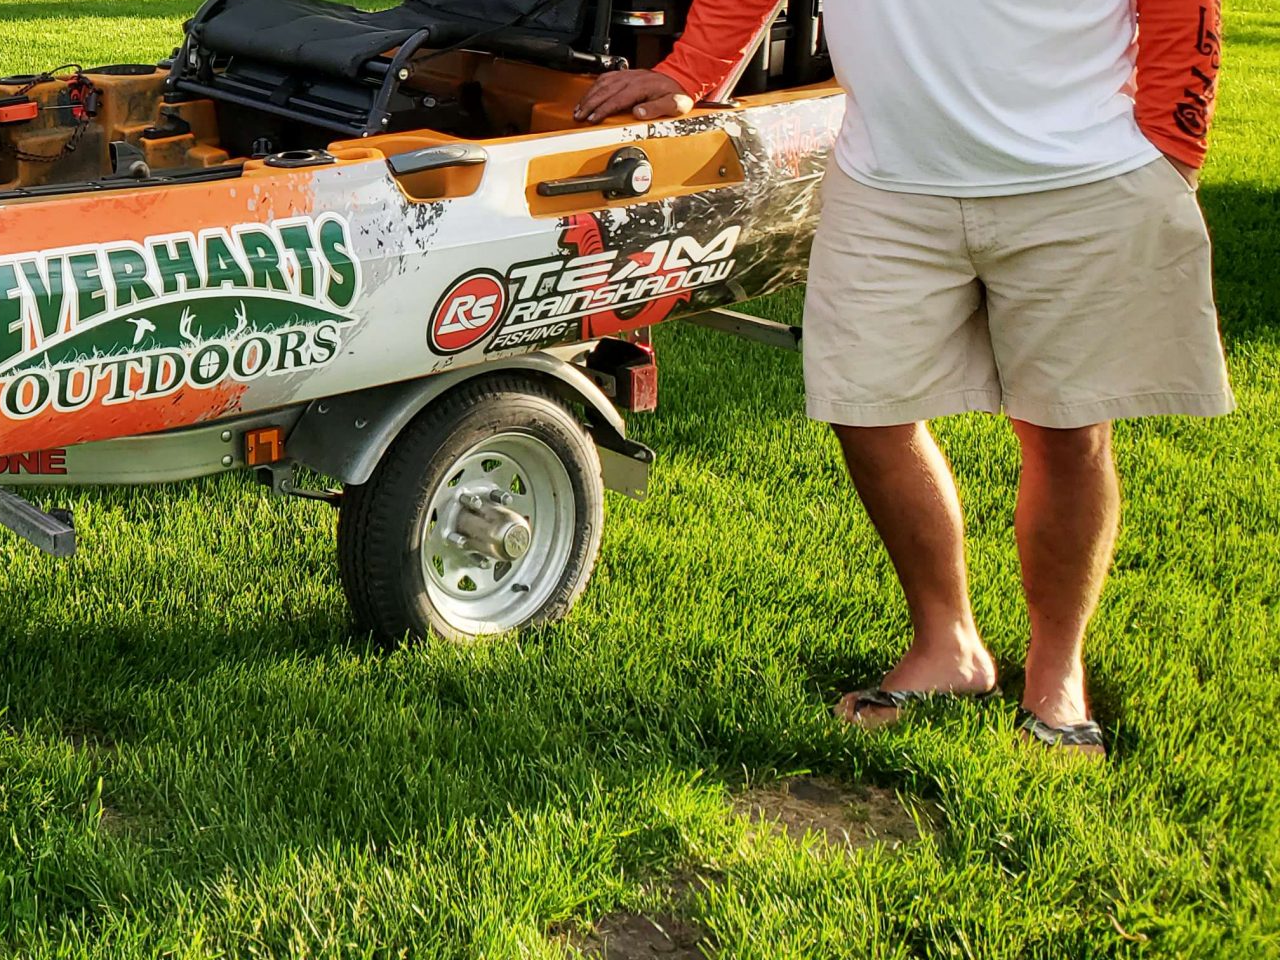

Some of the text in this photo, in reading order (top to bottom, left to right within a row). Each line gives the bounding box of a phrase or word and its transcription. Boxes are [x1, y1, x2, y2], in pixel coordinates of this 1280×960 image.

[505, 259, 737, 327] RAINSHADOW
[508, 226, 742, 300] TEAM
[436, 292, 499, 336] RS
[488, 322, 567, 350] FISHING
[4, 324, 340, 416] OUTDOORS
